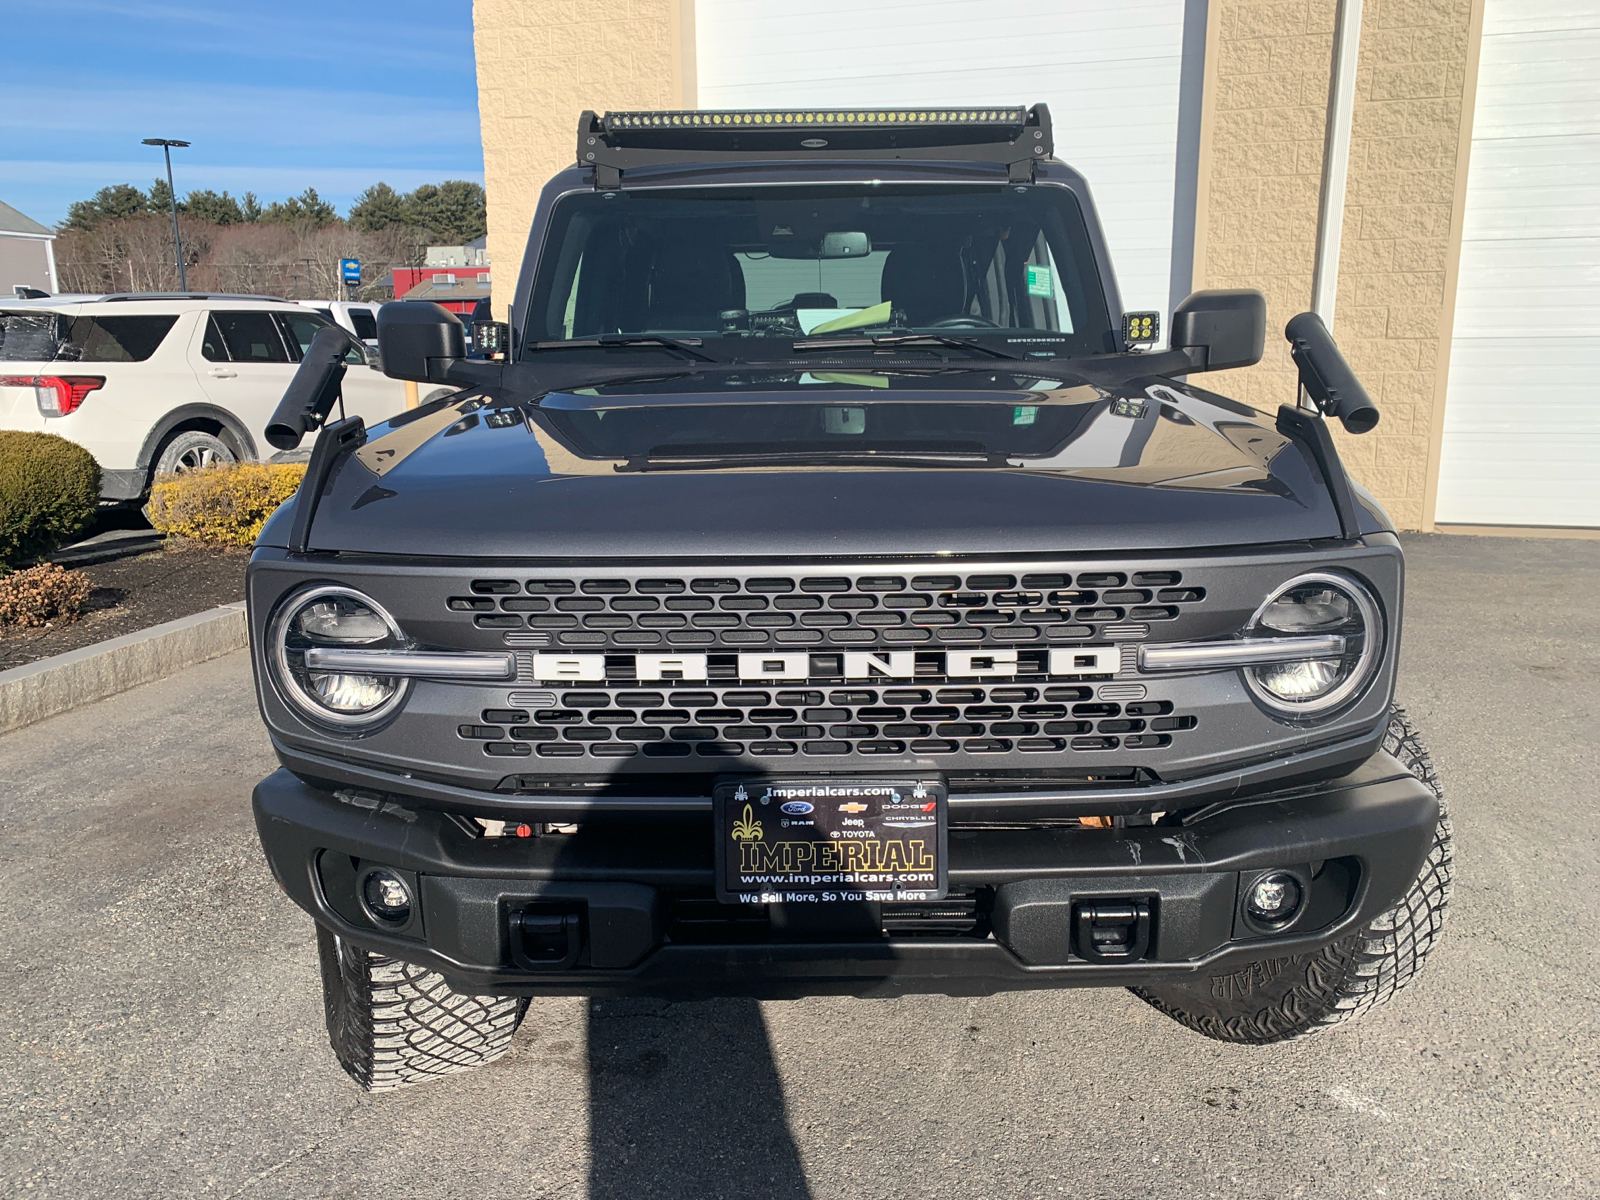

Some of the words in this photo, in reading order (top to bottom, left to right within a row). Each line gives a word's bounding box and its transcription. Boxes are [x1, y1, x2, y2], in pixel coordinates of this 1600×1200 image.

[533, 646, 1121, 681] BRONCO
[766, 785, 895, 799] Imperialcars.com
[787, 803, 807, 813] Ford
[841, 817, 865, 828] Jeep
[841, 830, 876, 838] TOYOTA
[740, 840, 934, 873] IMPERIAL
[740, 872, 934, 885] www.imperialcars.com
[739, 893, 758, 903] We
[761, 892, 783, 903] Sell
[786, 892, 819, 903] More,
[822, 891, 837, 902] So
[840, 891, 862, 901] You
[865, 890, 894, 901] Save
[897, 891, 927, 901] More
